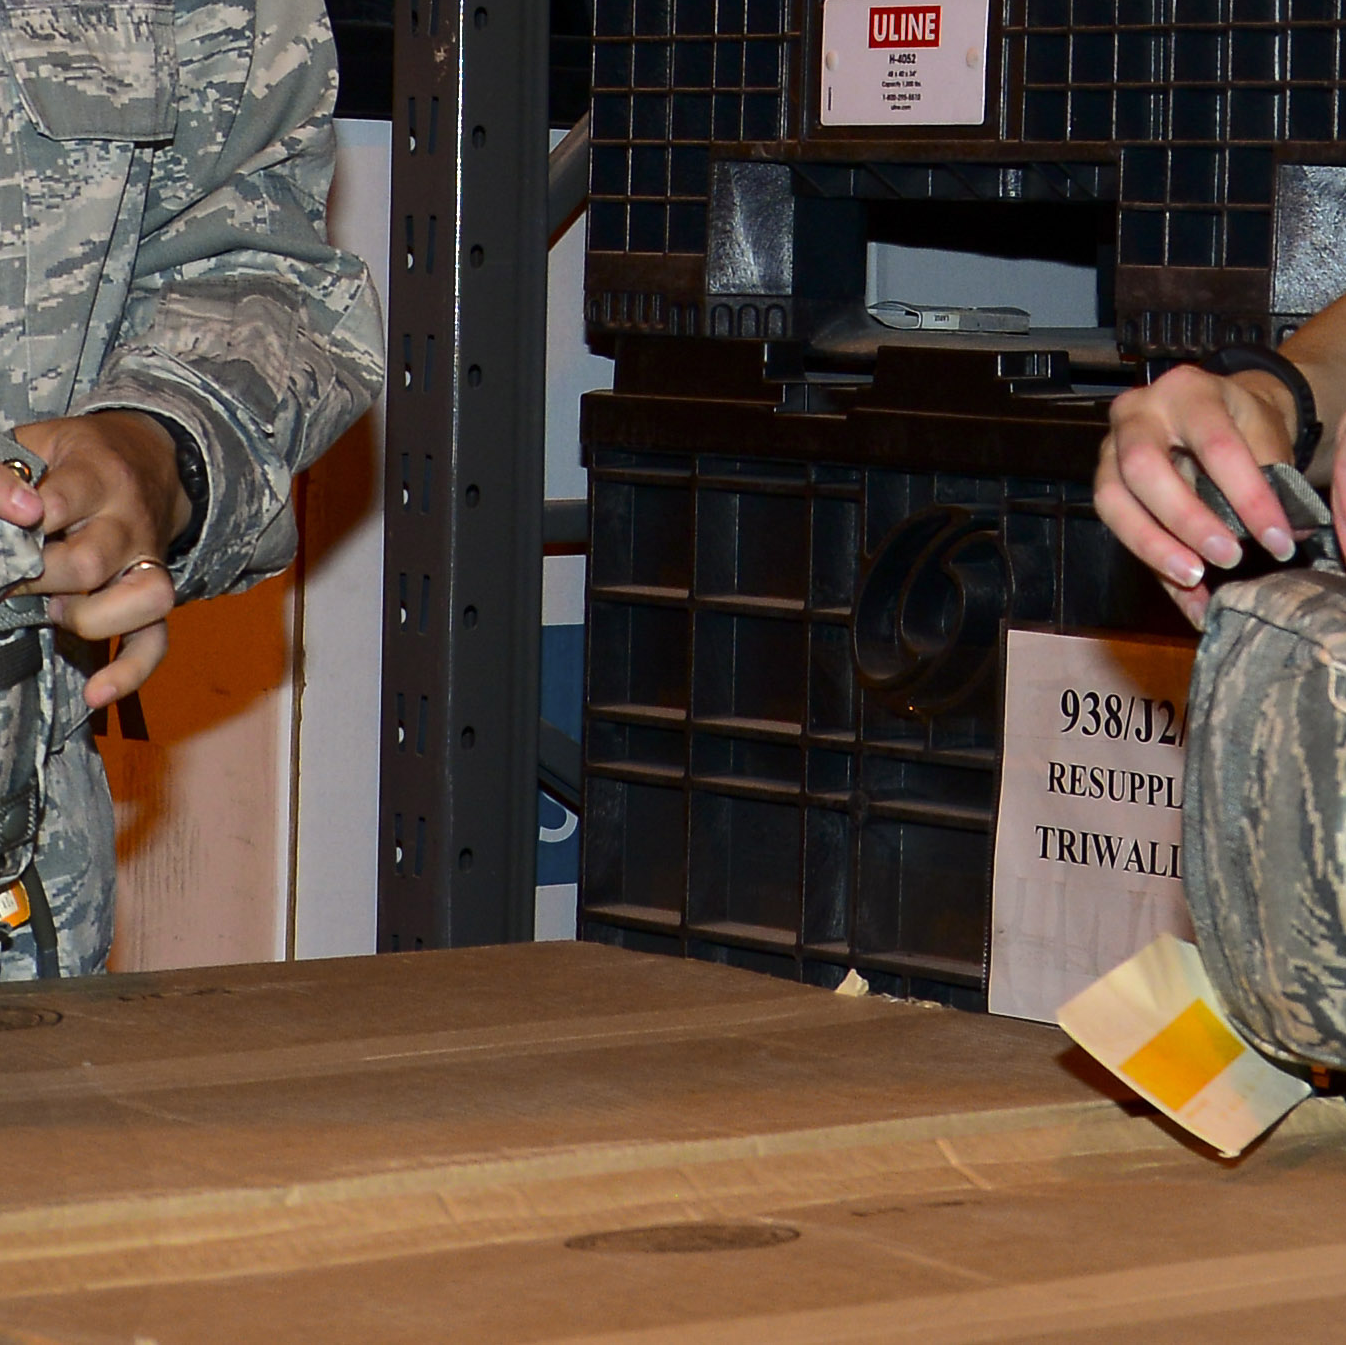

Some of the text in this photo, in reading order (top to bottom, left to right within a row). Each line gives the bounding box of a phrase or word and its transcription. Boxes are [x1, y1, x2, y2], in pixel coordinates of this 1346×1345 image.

[873, 12, 936, 42] ULINE
[1060, 688, 1189, 747] 938/J2/
[1047, 761, 1183, 809] RESUPPL
